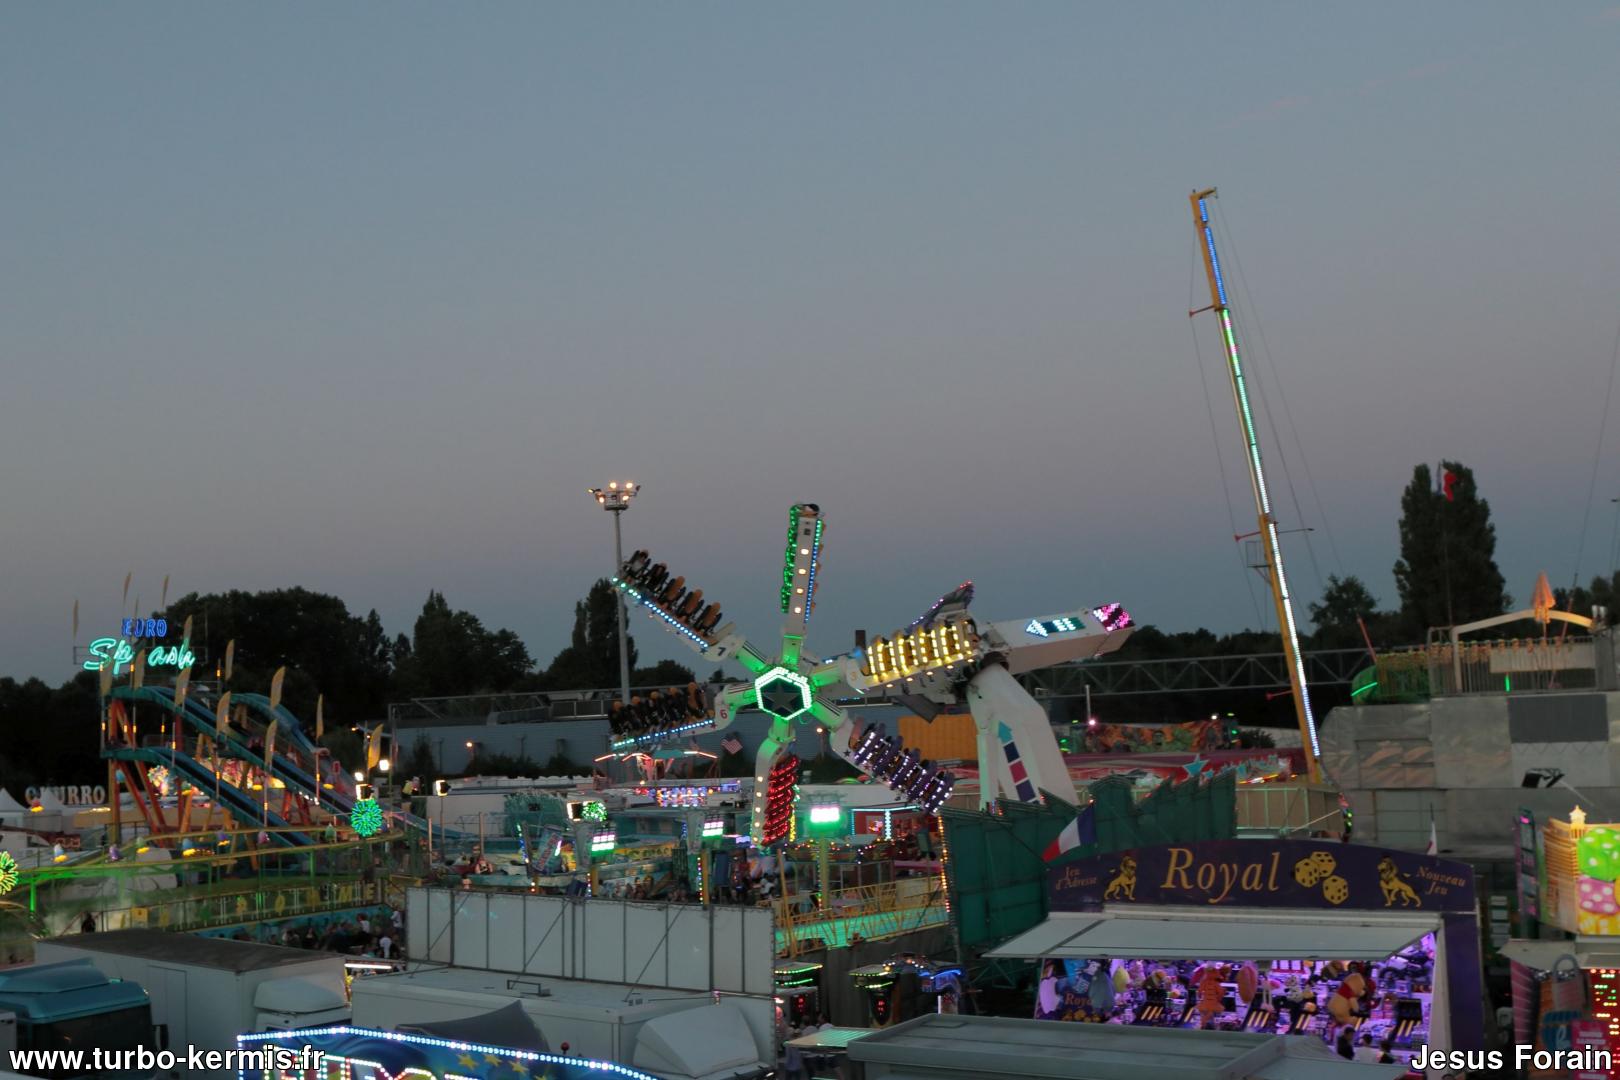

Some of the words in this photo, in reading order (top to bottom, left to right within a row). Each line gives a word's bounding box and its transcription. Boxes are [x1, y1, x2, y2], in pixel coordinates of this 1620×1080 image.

[122, 618, 167, 637] EURO
[84, 637, 196, 675] Spash
[717, 646, 727, 656] 7
[720, 709, 729, 719] 6
[1160, 848, 1281, 904] Royal
[1416, 865, 1466, 887] Nouveau
